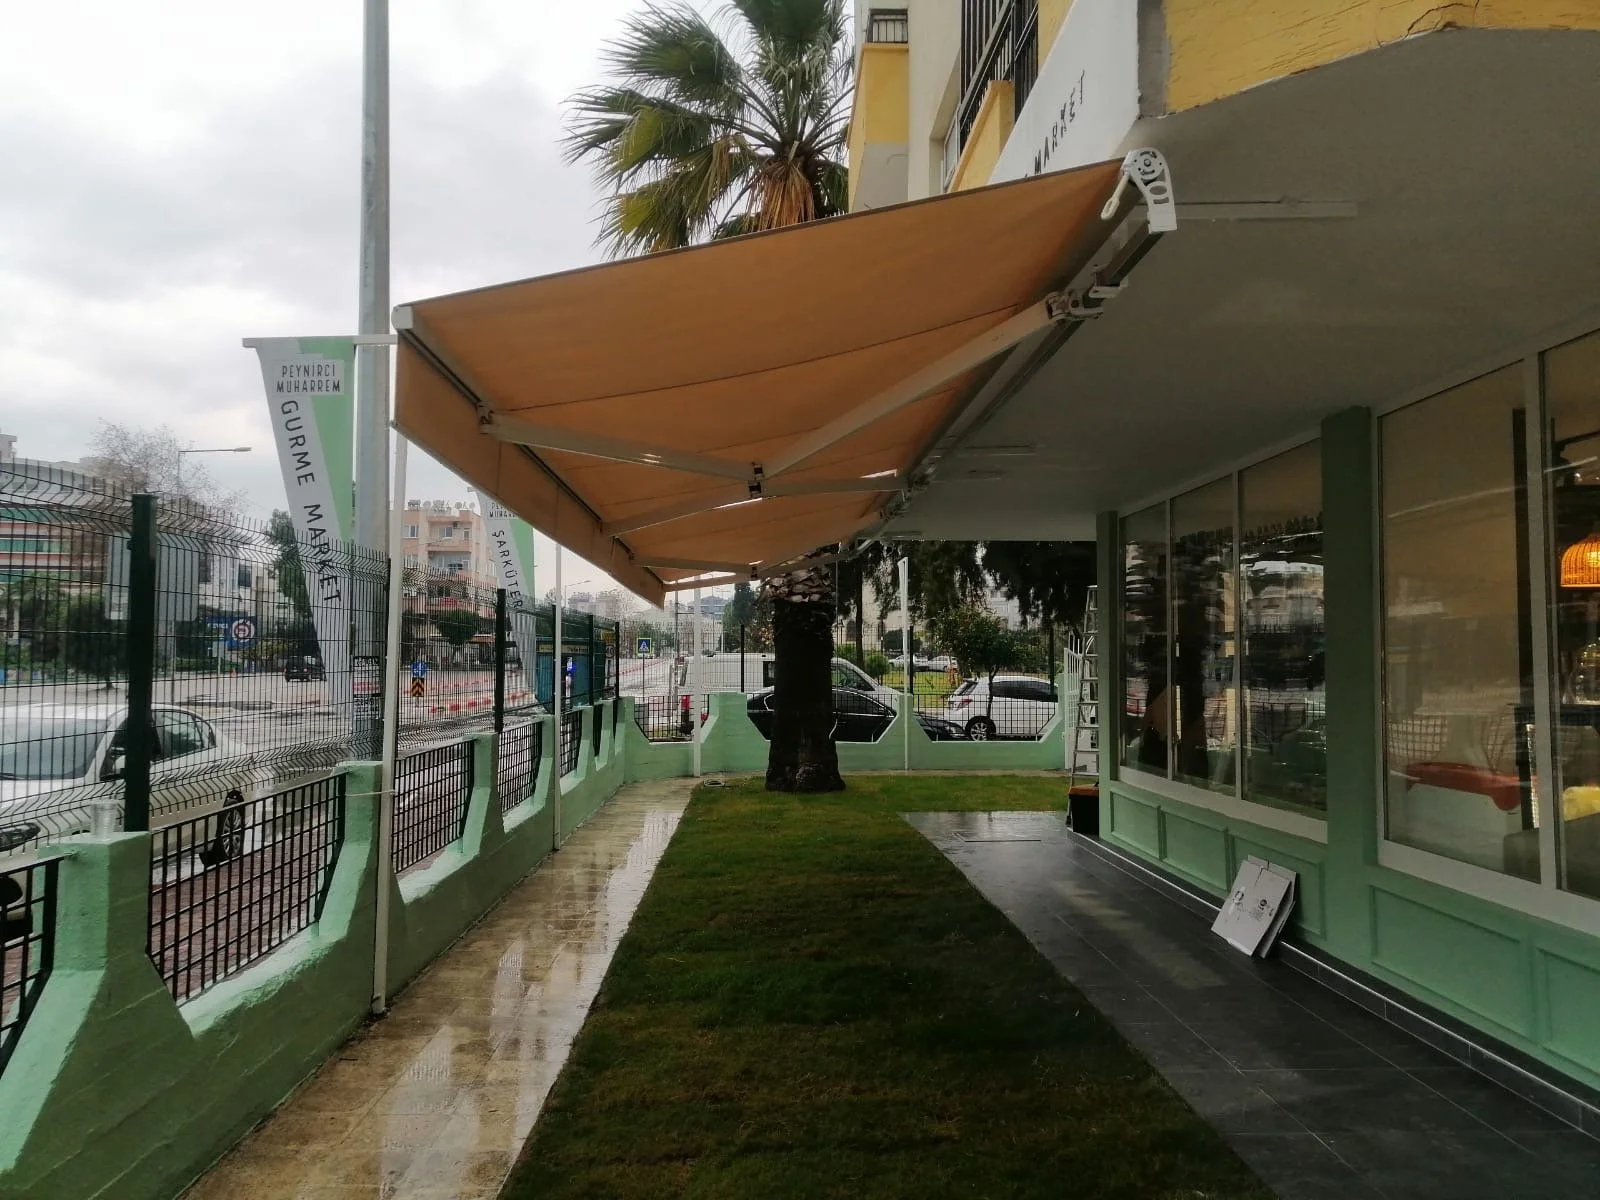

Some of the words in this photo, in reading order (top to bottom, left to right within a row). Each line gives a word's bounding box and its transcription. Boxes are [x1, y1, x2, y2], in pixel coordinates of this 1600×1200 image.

[1034, 68, 1085, 176] MARKET
[276, 379, 341, 393] MUHARREM
[281, 362, 336, 378] PEYNİRCİ
[280, 400, 316, 486] GURME
[303, 504, 342, 602] MARKET
